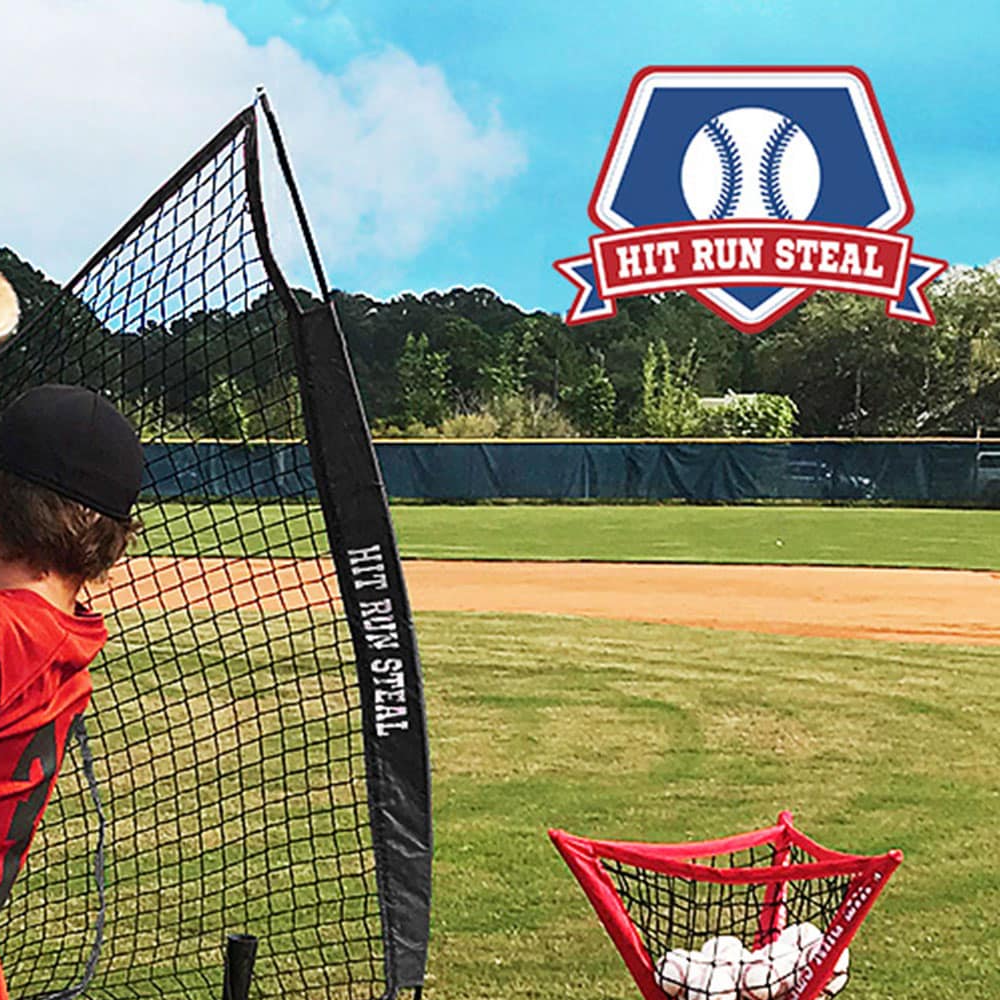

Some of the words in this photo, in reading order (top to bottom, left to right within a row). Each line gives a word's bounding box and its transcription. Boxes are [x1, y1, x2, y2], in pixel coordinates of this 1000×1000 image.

[347, 544, 388, 590] HIT
[359, 598, 399, 650] RUN
[370, 658, 409, 737] STEAL
